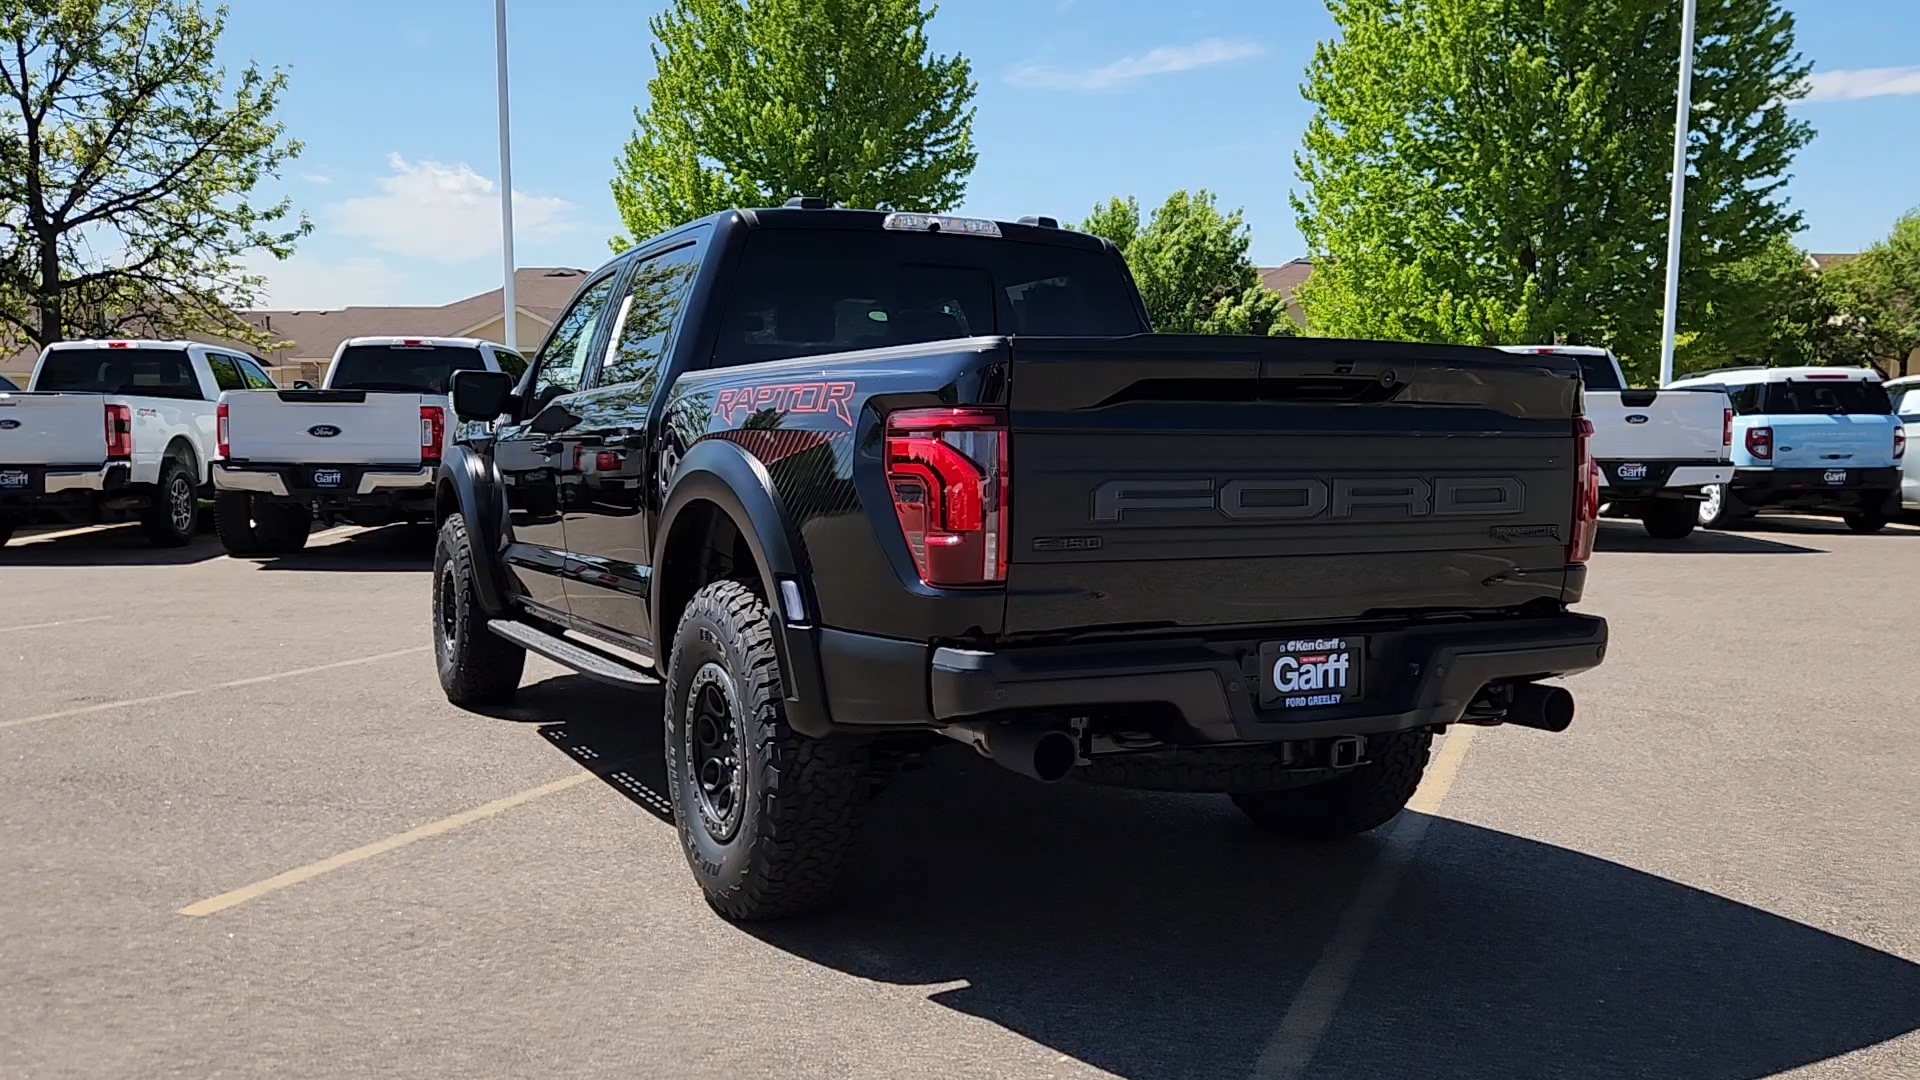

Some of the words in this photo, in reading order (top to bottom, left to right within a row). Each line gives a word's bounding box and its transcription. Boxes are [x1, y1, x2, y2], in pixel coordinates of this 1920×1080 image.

[713, 381, 855, 426] RAPTOR
[314, 427, 334, 436] Ford
[314, 473, 341, 484] Garff
[1618, 466, 1647, 477] Garff
[0, 473, 28, 485] Garff
[1090, 475, 1526, 521] FORD
[1296, 640, 1315, 652] Ken
[1315, 638, 1339, 651] Garff
[1273, 653, 1349, 692] Garff
[1285, 697, 1306, 708] FORD
[1307, 694, 1341, 706] GREELEY
